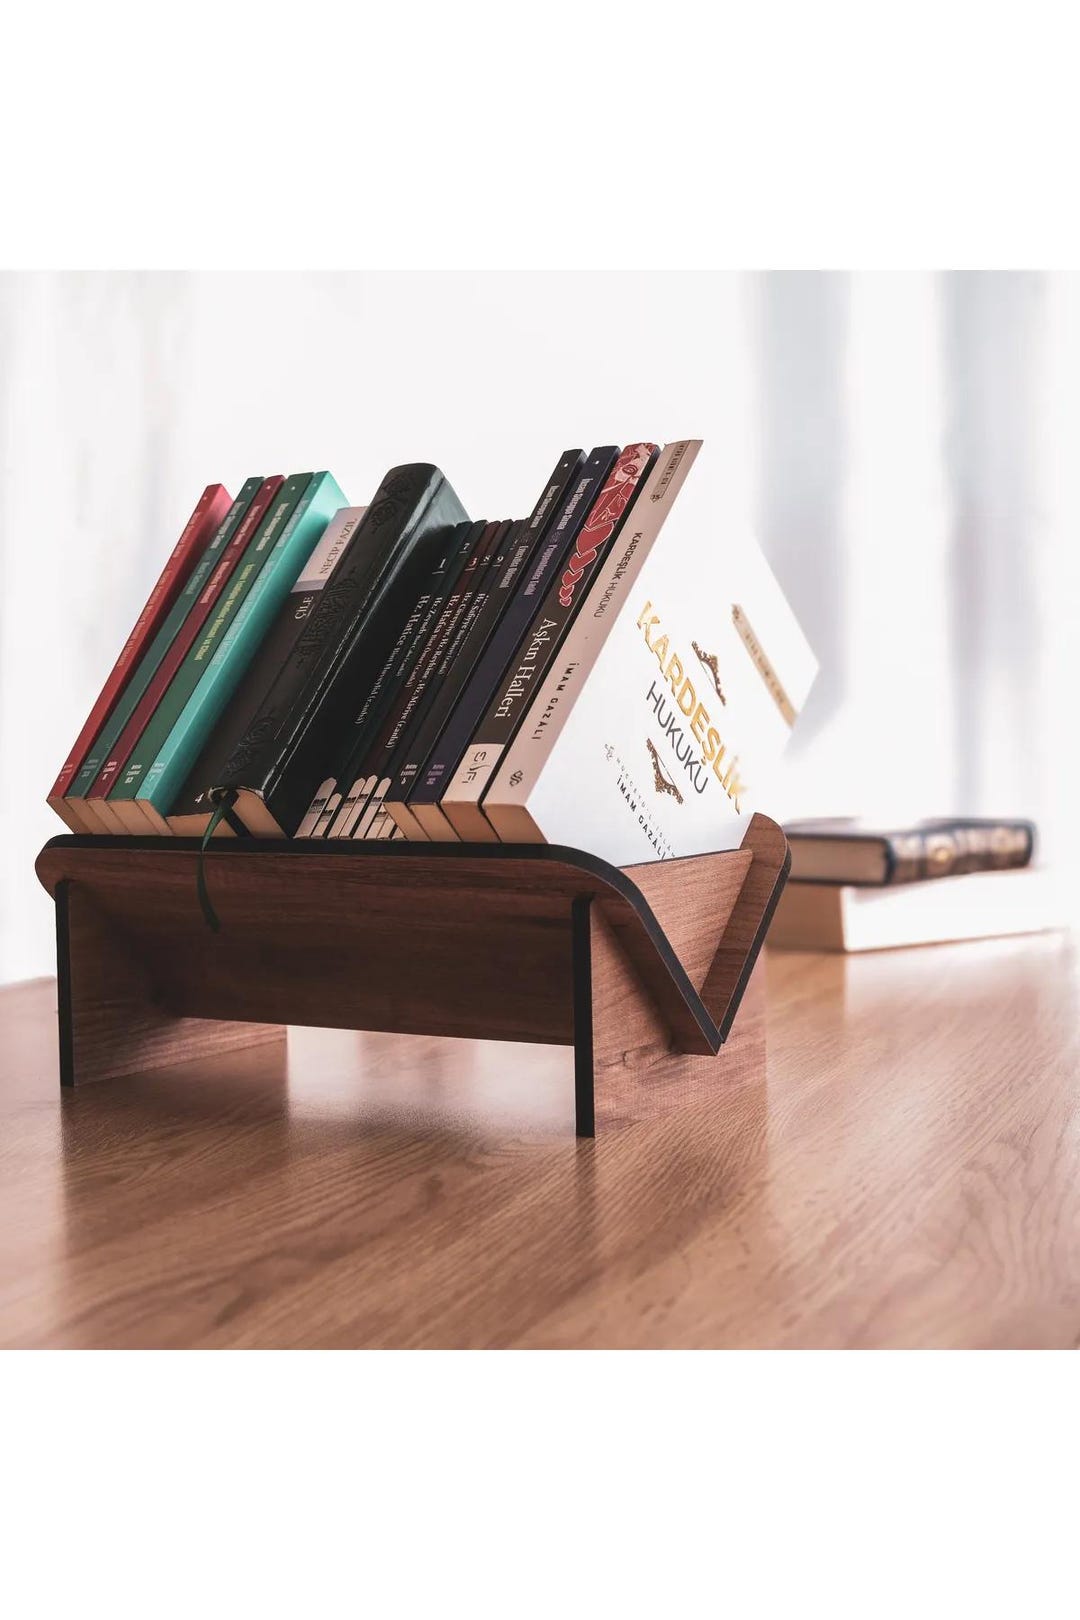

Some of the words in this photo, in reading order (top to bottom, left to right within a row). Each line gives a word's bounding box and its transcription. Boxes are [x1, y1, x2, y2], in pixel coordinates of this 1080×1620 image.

[612, 532, 643, 579] KARDEŞLİK
[414, 595, 430, 612] Hz.
[446, 595, 460, 609] Hz.
[594, 582, 617, 618] HUKUKU
[397, 614, 420, 645] Hatice
[433, 610, 452, 633] Hafsa
[524, 618, 557, 661] Aşkın
[413, 683, 425, 695] Hz.
[495, 665, 537, 718] Halleri
[556, 662, 580, 691] İMAM
[637, 601, 746, 815] KARDEŞLİK
[646, 681, 708, 794] HUKUKU
[617, 774, 637, 812] İMAM
